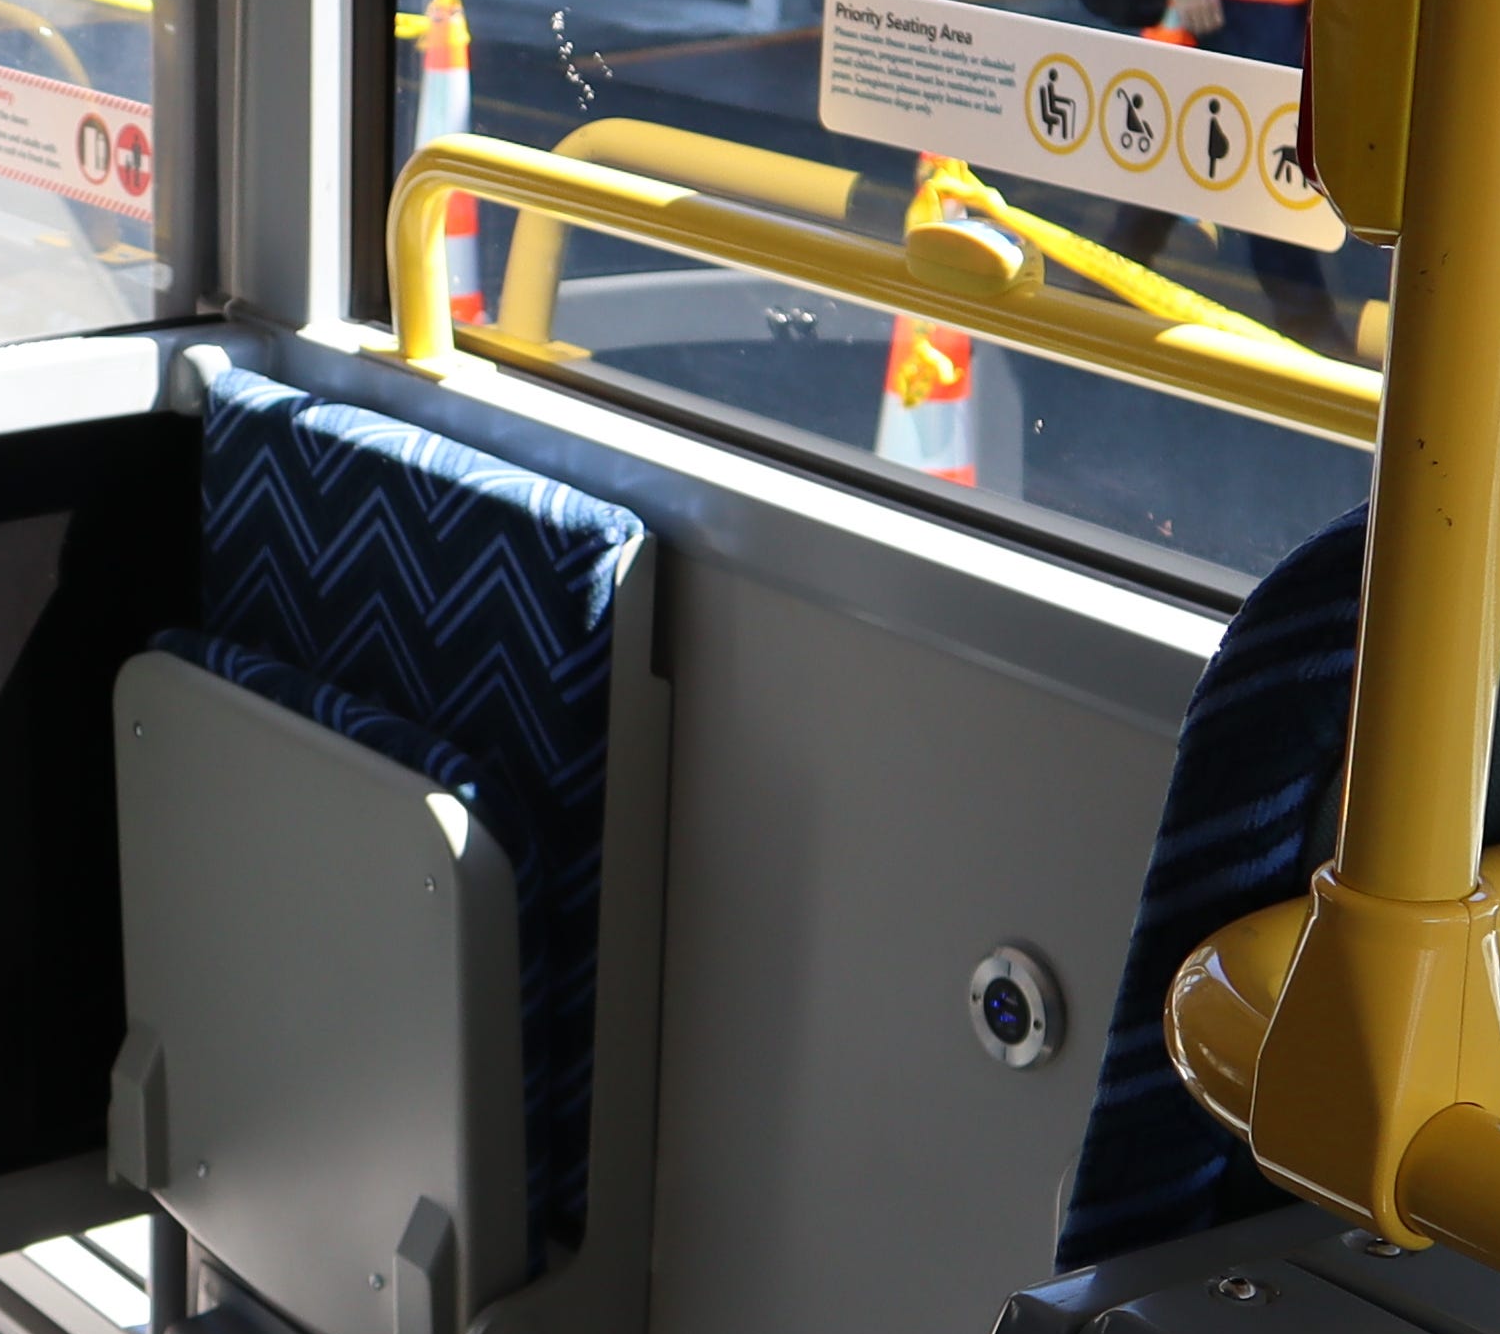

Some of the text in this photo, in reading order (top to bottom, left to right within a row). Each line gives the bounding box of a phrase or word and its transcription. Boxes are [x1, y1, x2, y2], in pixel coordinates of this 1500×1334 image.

[835, 1, 973, 45] Priority Seating Area
